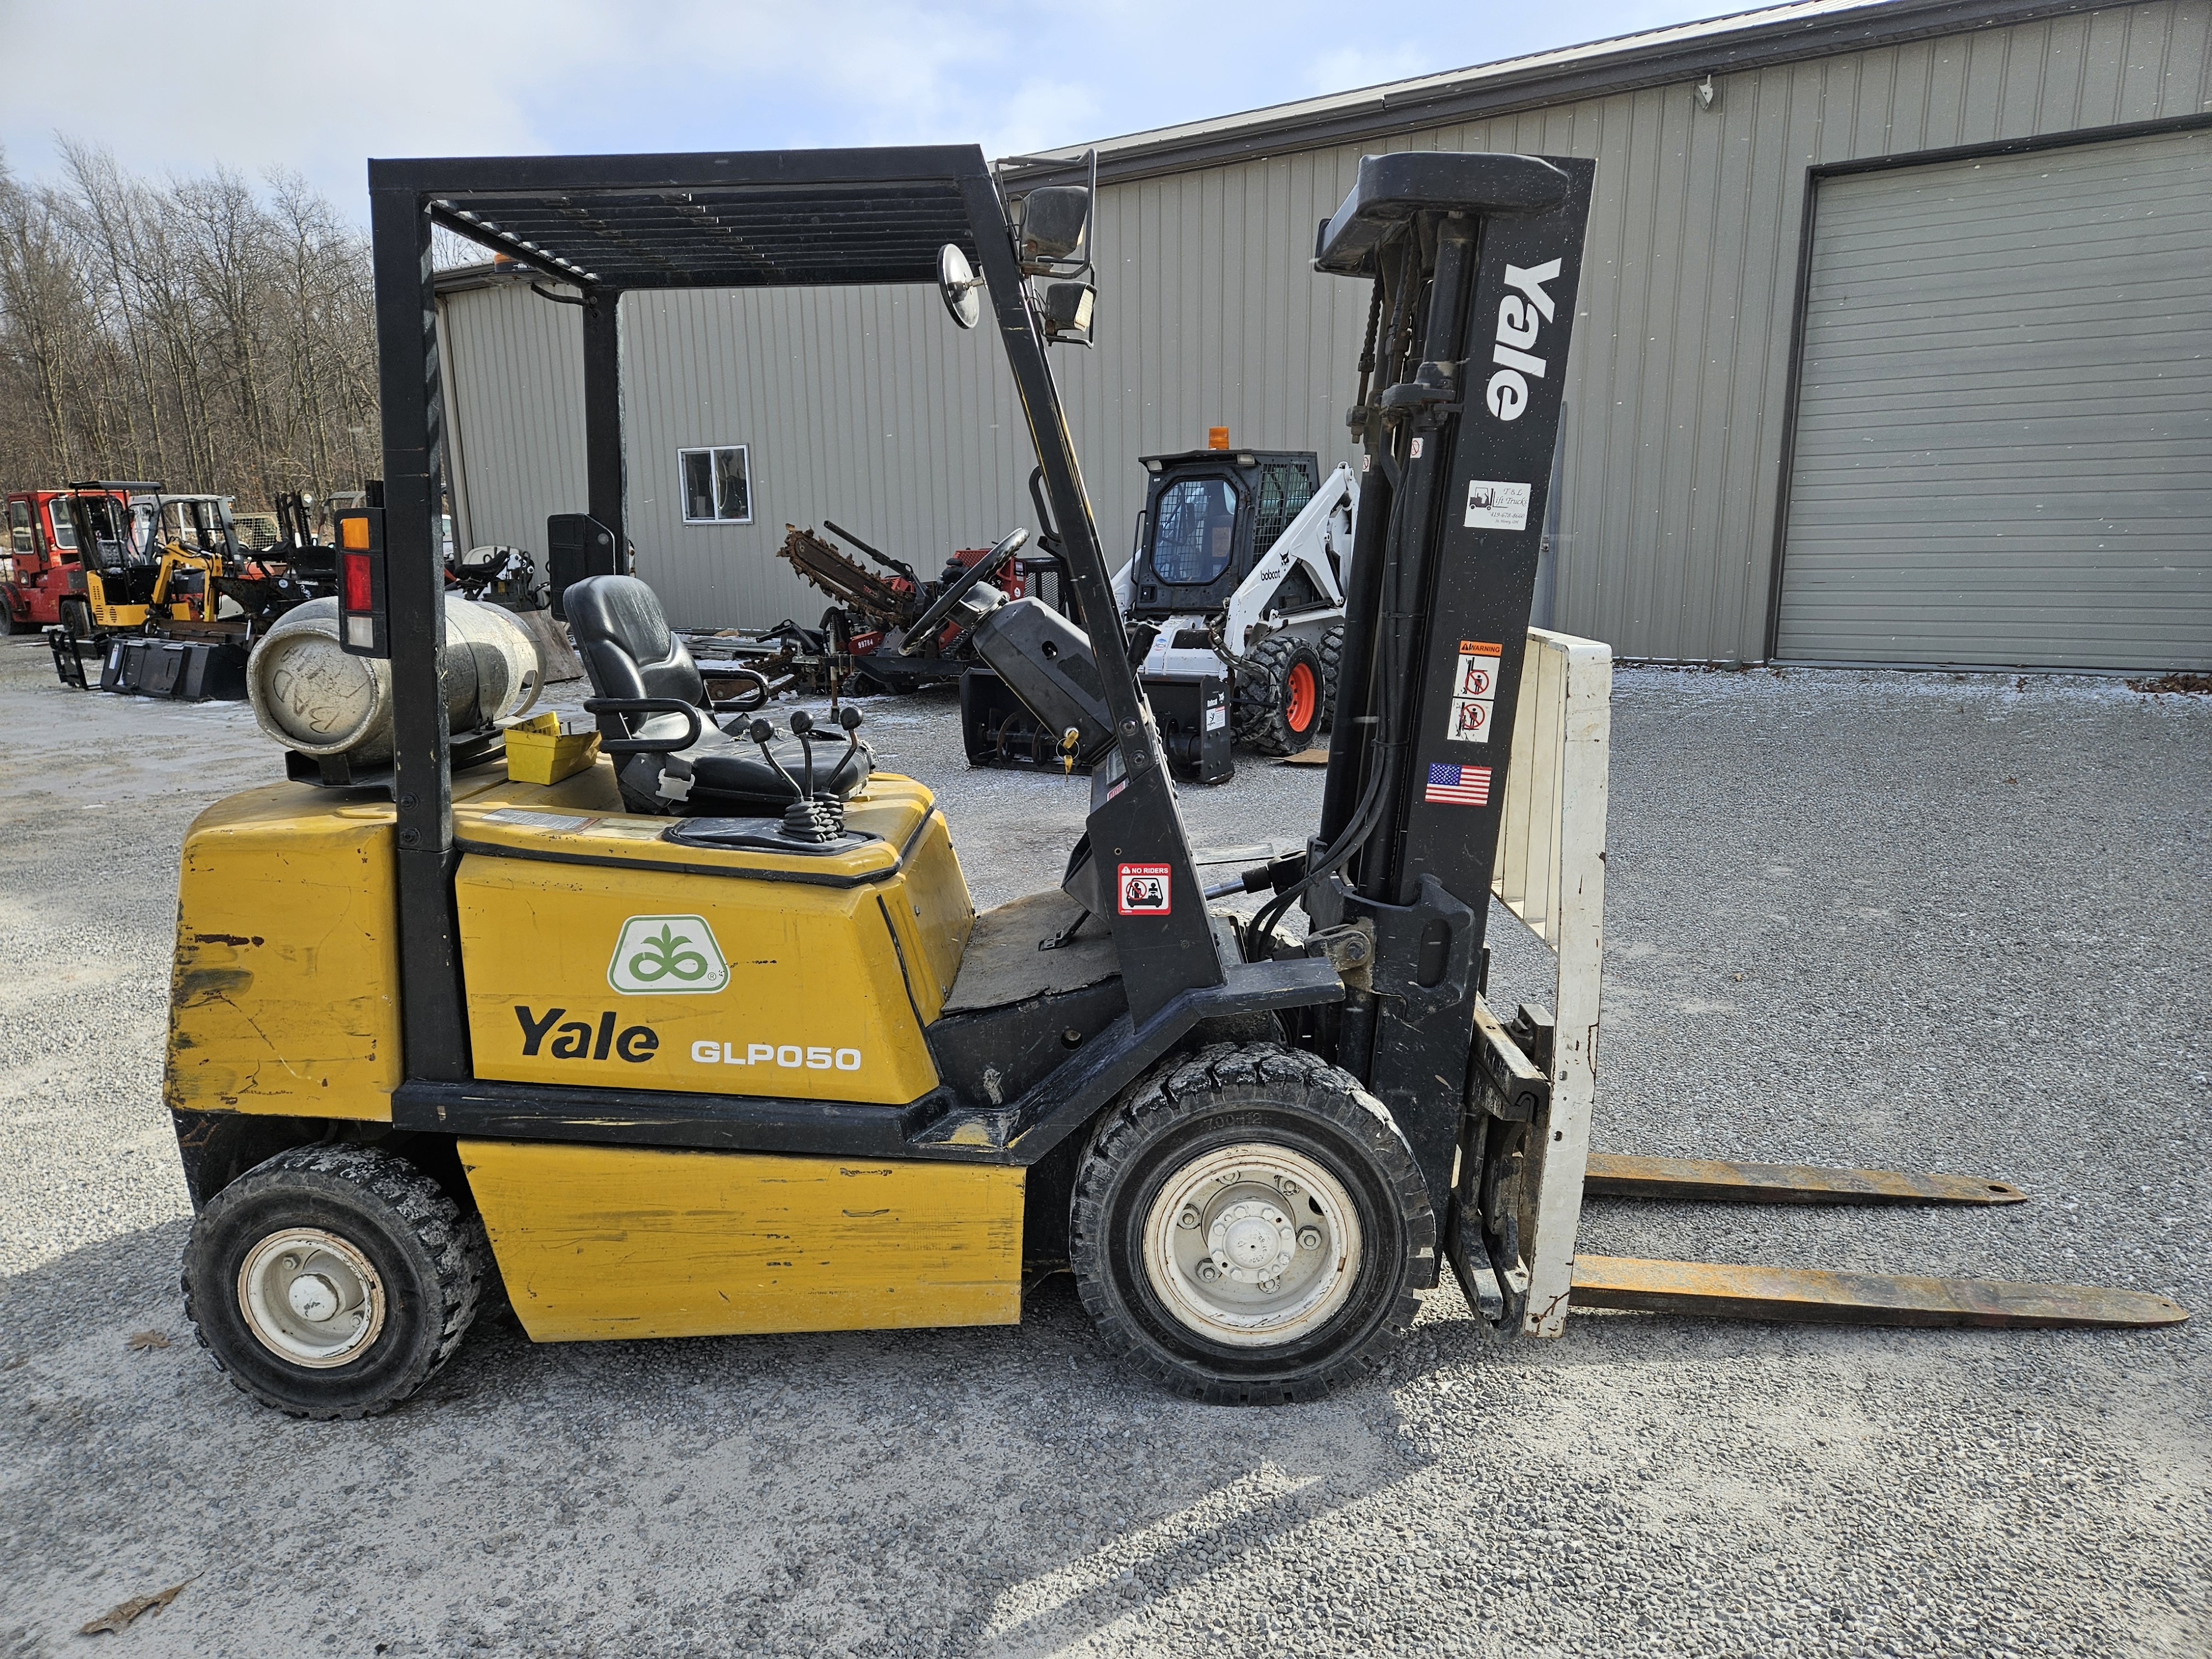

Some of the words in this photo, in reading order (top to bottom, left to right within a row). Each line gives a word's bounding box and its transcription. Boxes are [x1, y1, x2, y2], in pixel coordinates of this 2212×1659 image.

[1486, 258, 1562, 421] Yale
[1506, 497, 1527, 507] Trucks
[1260, 568, 1280, 581] bobcat
[858, 639, 873, 649] 99784
[1470, 644, 1500, 653] WARNING
[514, 1005, 659, 1063] Yale
[691, 1040, 861, 1071] GLP050
